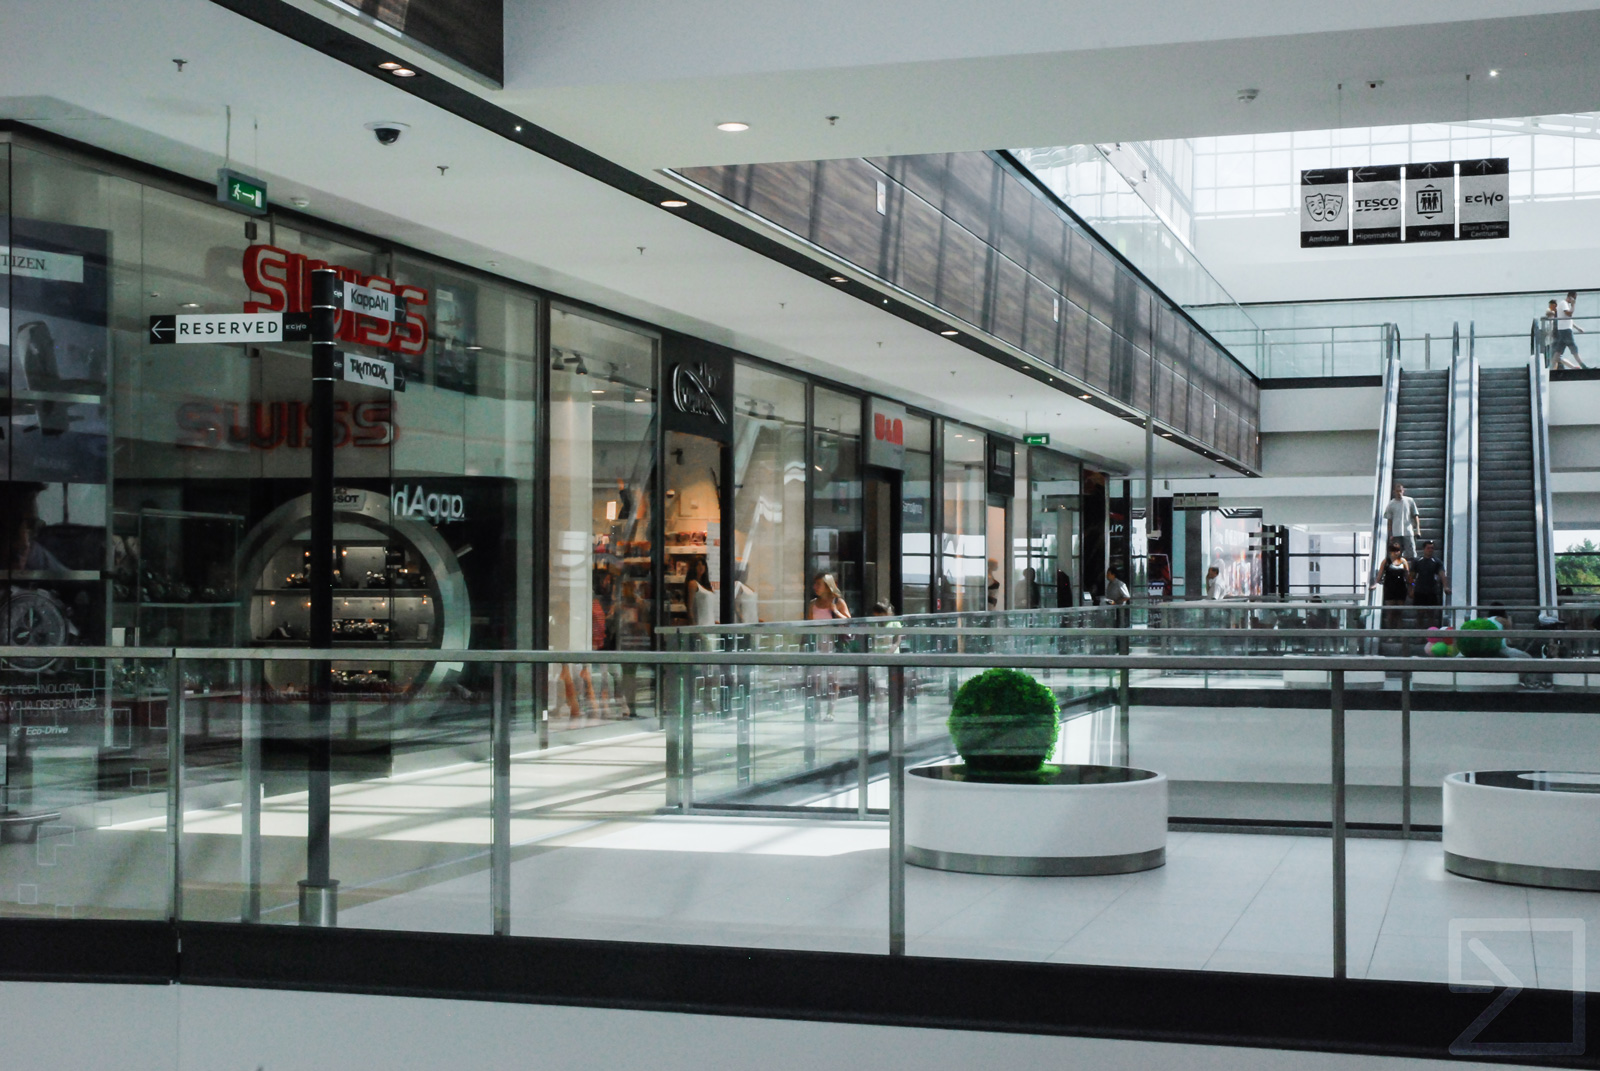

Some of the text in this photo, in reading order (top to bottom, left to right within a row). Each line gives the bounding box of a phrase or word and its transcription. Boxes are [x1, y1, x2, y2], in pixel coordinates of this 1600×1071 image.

[1355, 198, 1398, 208] TESCO
[1465, 191, 1504, 206] ECHO
[1356, 231, 1398, 240] Hipermarket
[1419, 230, 1441, 238] Windy
[1470, 230, 1499, 238] Centrum
[1308, 235, 1340, 243] Amfiteatr
[0, 254, 46, 271] TIZEN
[350, 288, 389, 312] KappAhl
[179, 321, 278, 335] RESERVED
[26, 726, 69, 735] Eco-Drive
